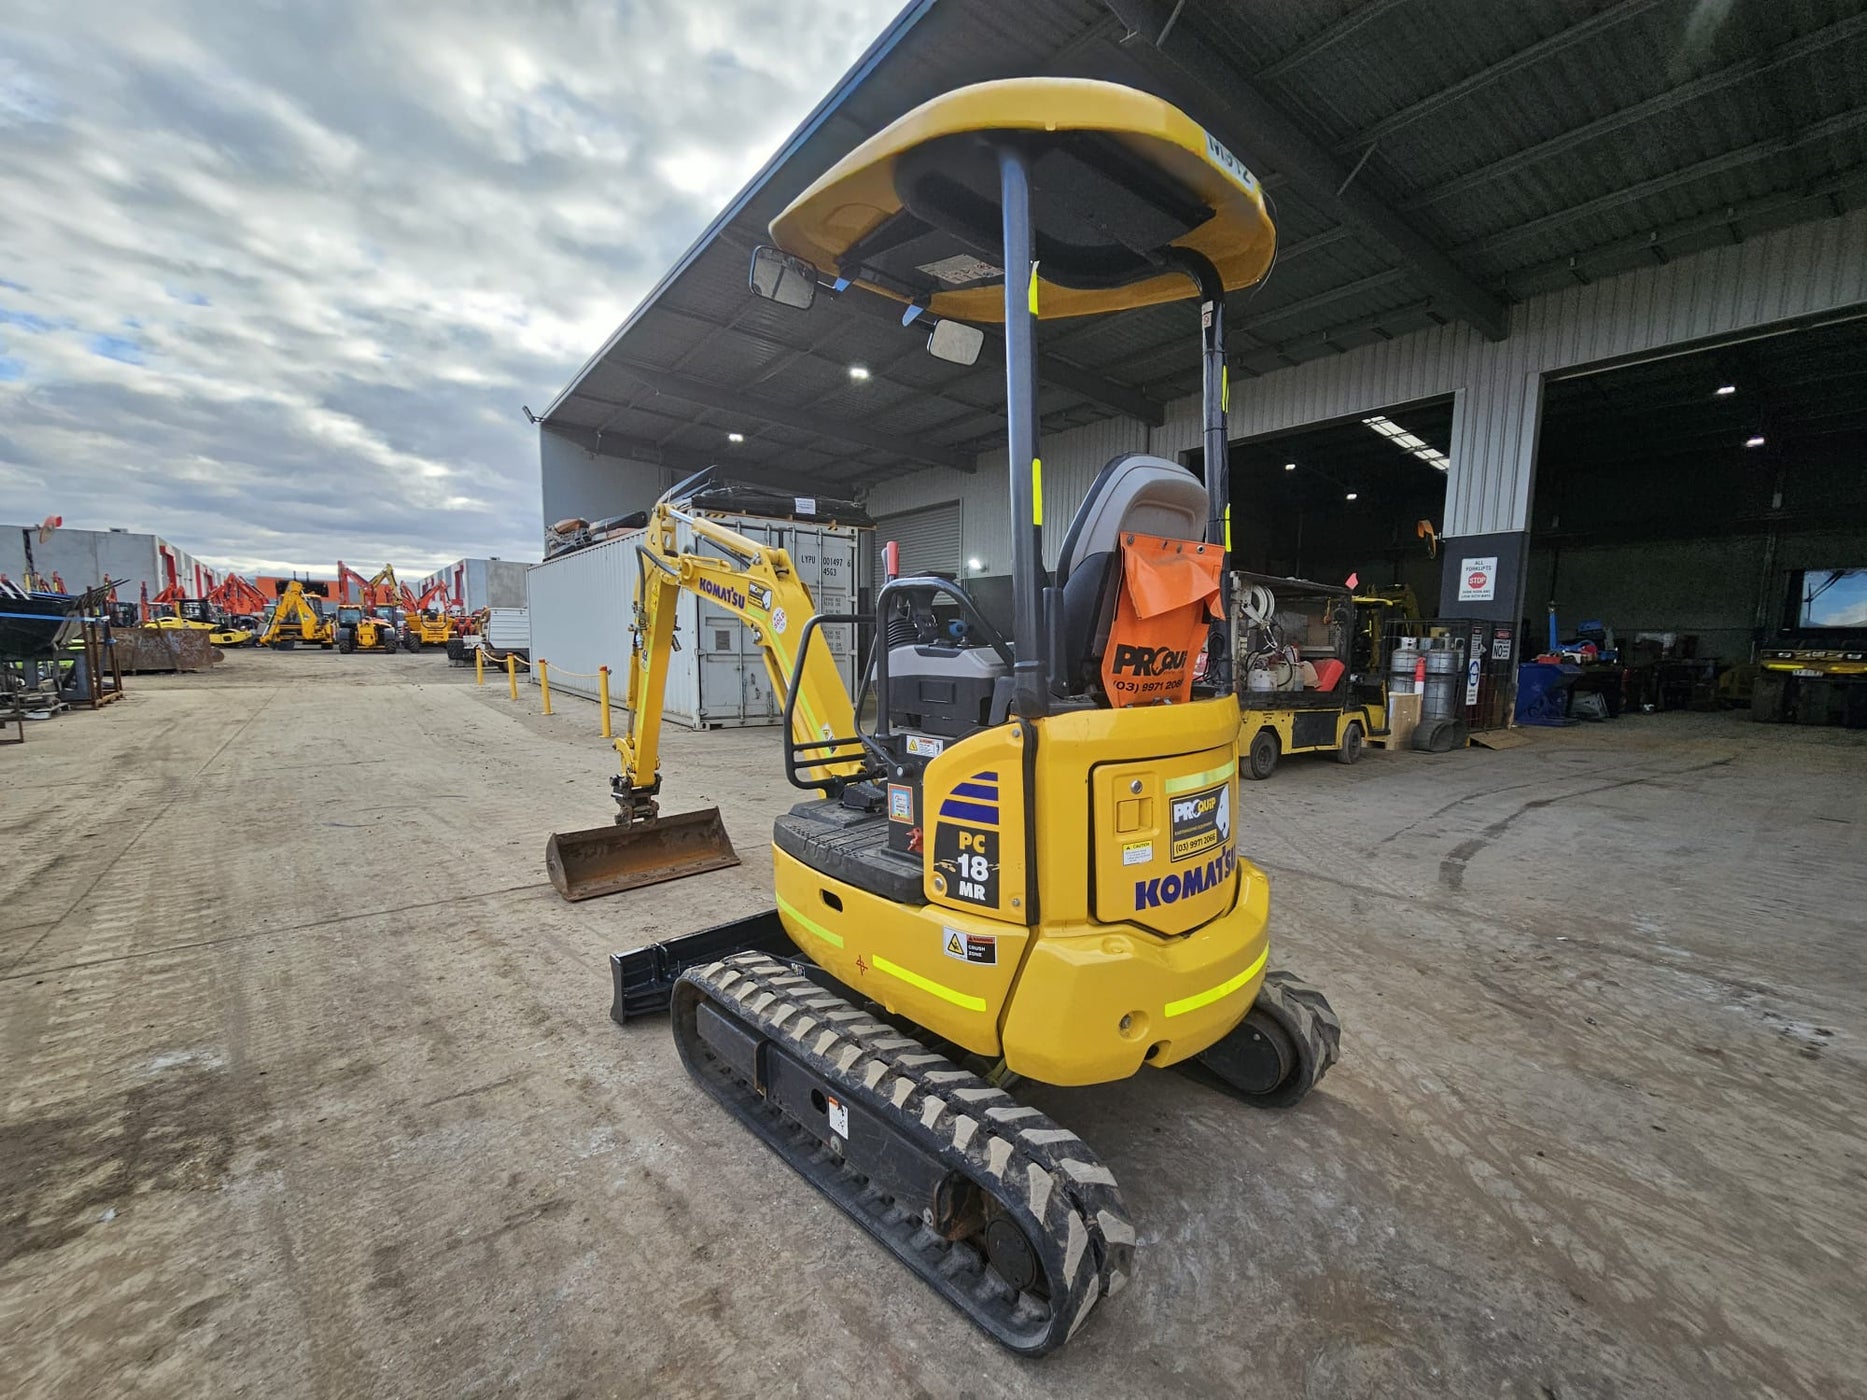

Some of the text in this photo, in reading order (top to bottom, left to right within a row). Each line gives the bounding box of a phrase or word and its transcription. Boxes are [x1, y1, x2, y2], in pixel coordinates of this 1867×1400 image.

[1469, 577, 1487, 585] STOP
[699, 577, 746, 610] KOMATSU
[1112, 643, 1188, 676] PROQUI
[1113, 680, 1139, 694] (03)
[1141, 681, 1164, 692] 9971
[959, 830, 986, 854] PC
[1175, 842, 1189, 854] (03)
[1189, 838, 1204, 849] 9971
[958, 853, 989, 881] 18
[1135, 844, 1236, 911] KOMATSU
[959, 880, 986, 901] MR
[968, 944, 986, 952] CRUSH
